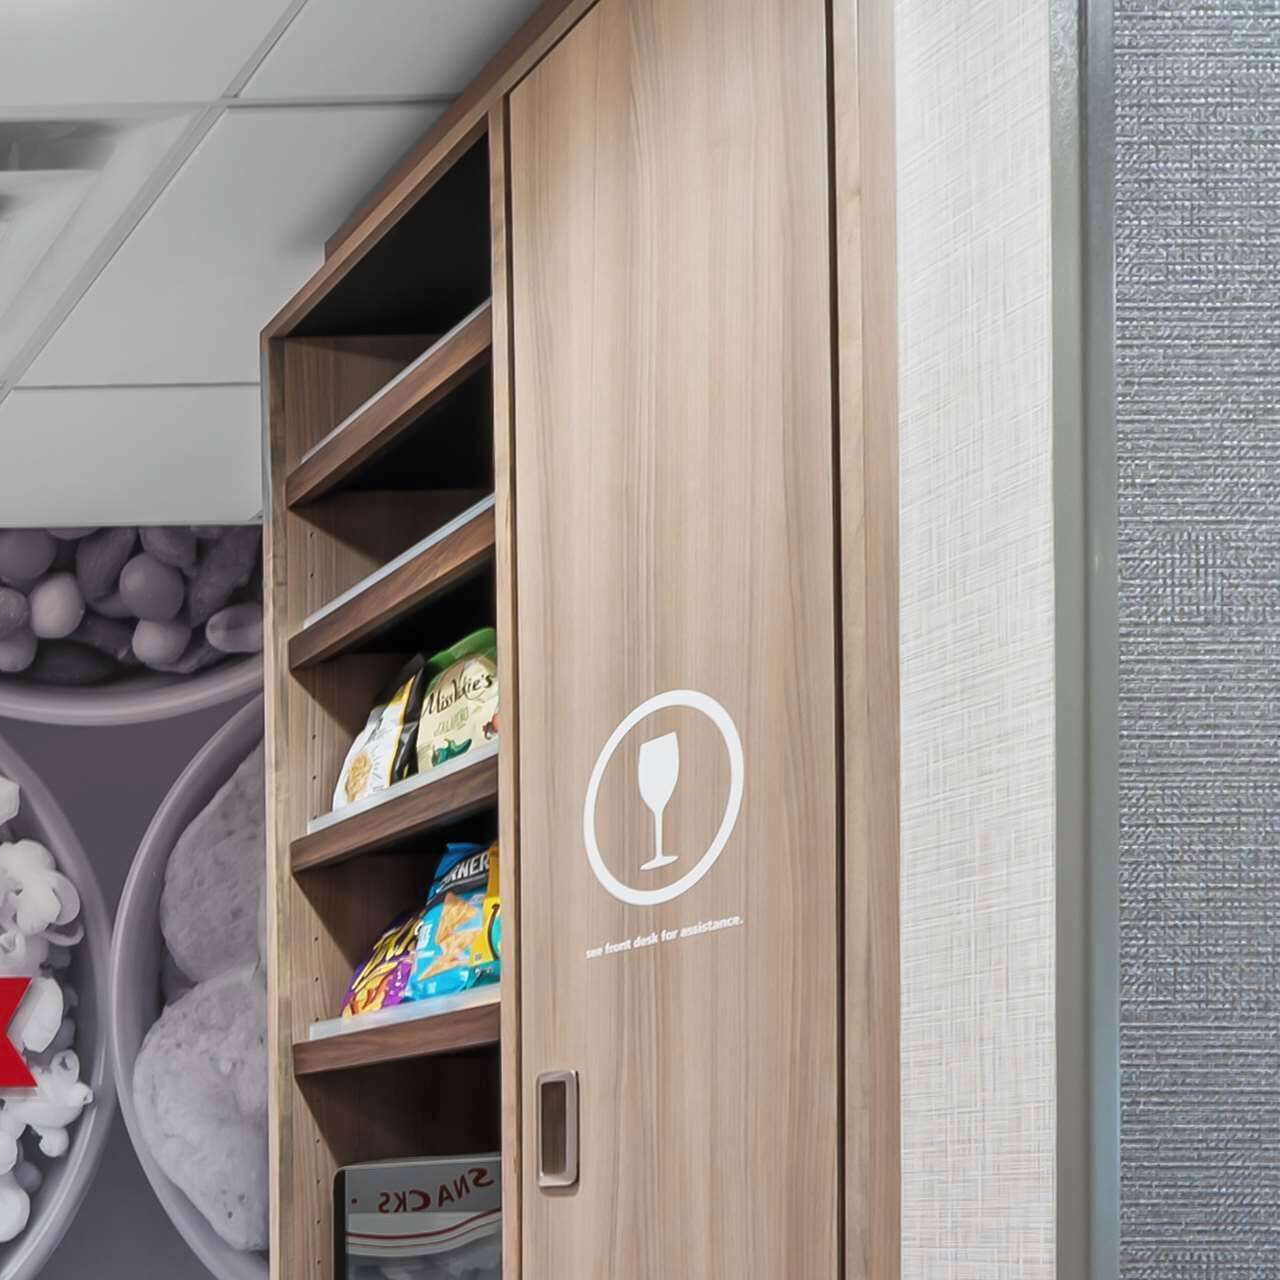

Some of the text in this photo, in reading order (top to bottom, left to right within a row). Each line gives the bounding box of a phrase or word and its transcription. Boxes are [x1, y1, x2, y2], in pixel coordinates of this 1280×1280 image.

[604, 939, 633, 956] front
[633, 932, 659, 950] desk
[660, 926, 679, 943] for
[679, 914, 745, 938] assistance.
